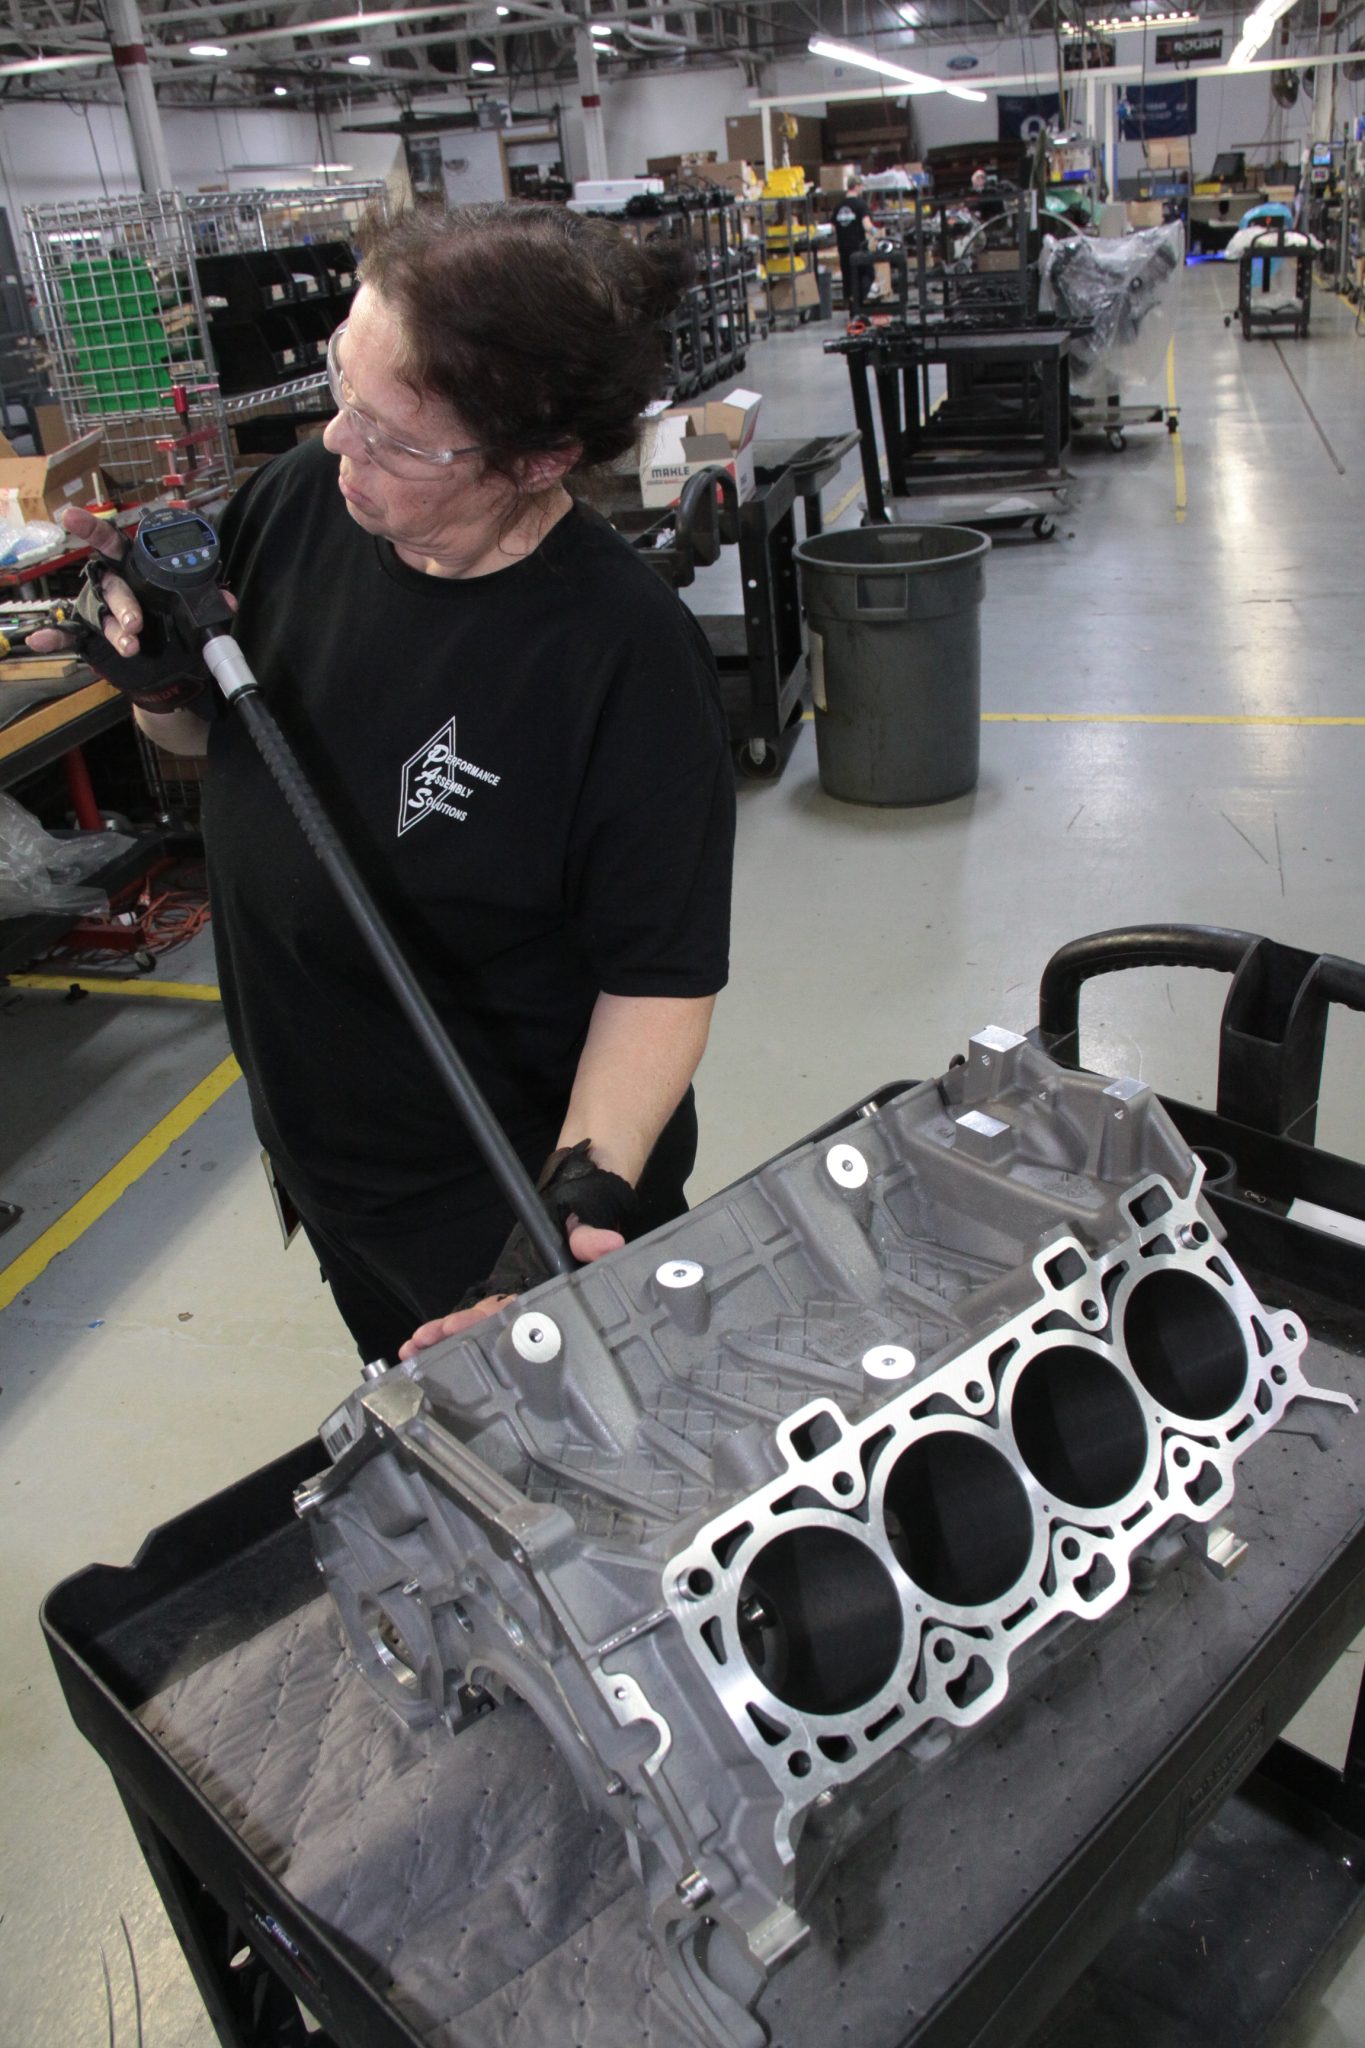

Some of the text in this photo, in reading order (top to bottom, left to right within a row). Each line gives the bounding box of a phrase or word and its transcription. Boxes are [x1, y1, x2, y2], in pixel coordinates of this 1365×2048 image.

[651, 466, 690, 479] MAHLE
[422, 743, 502, 787] PERFORMANCE
[414, 766, 474, 799] ASSEMBLY
[407, 787, 468, 822] SOLUTIONS
